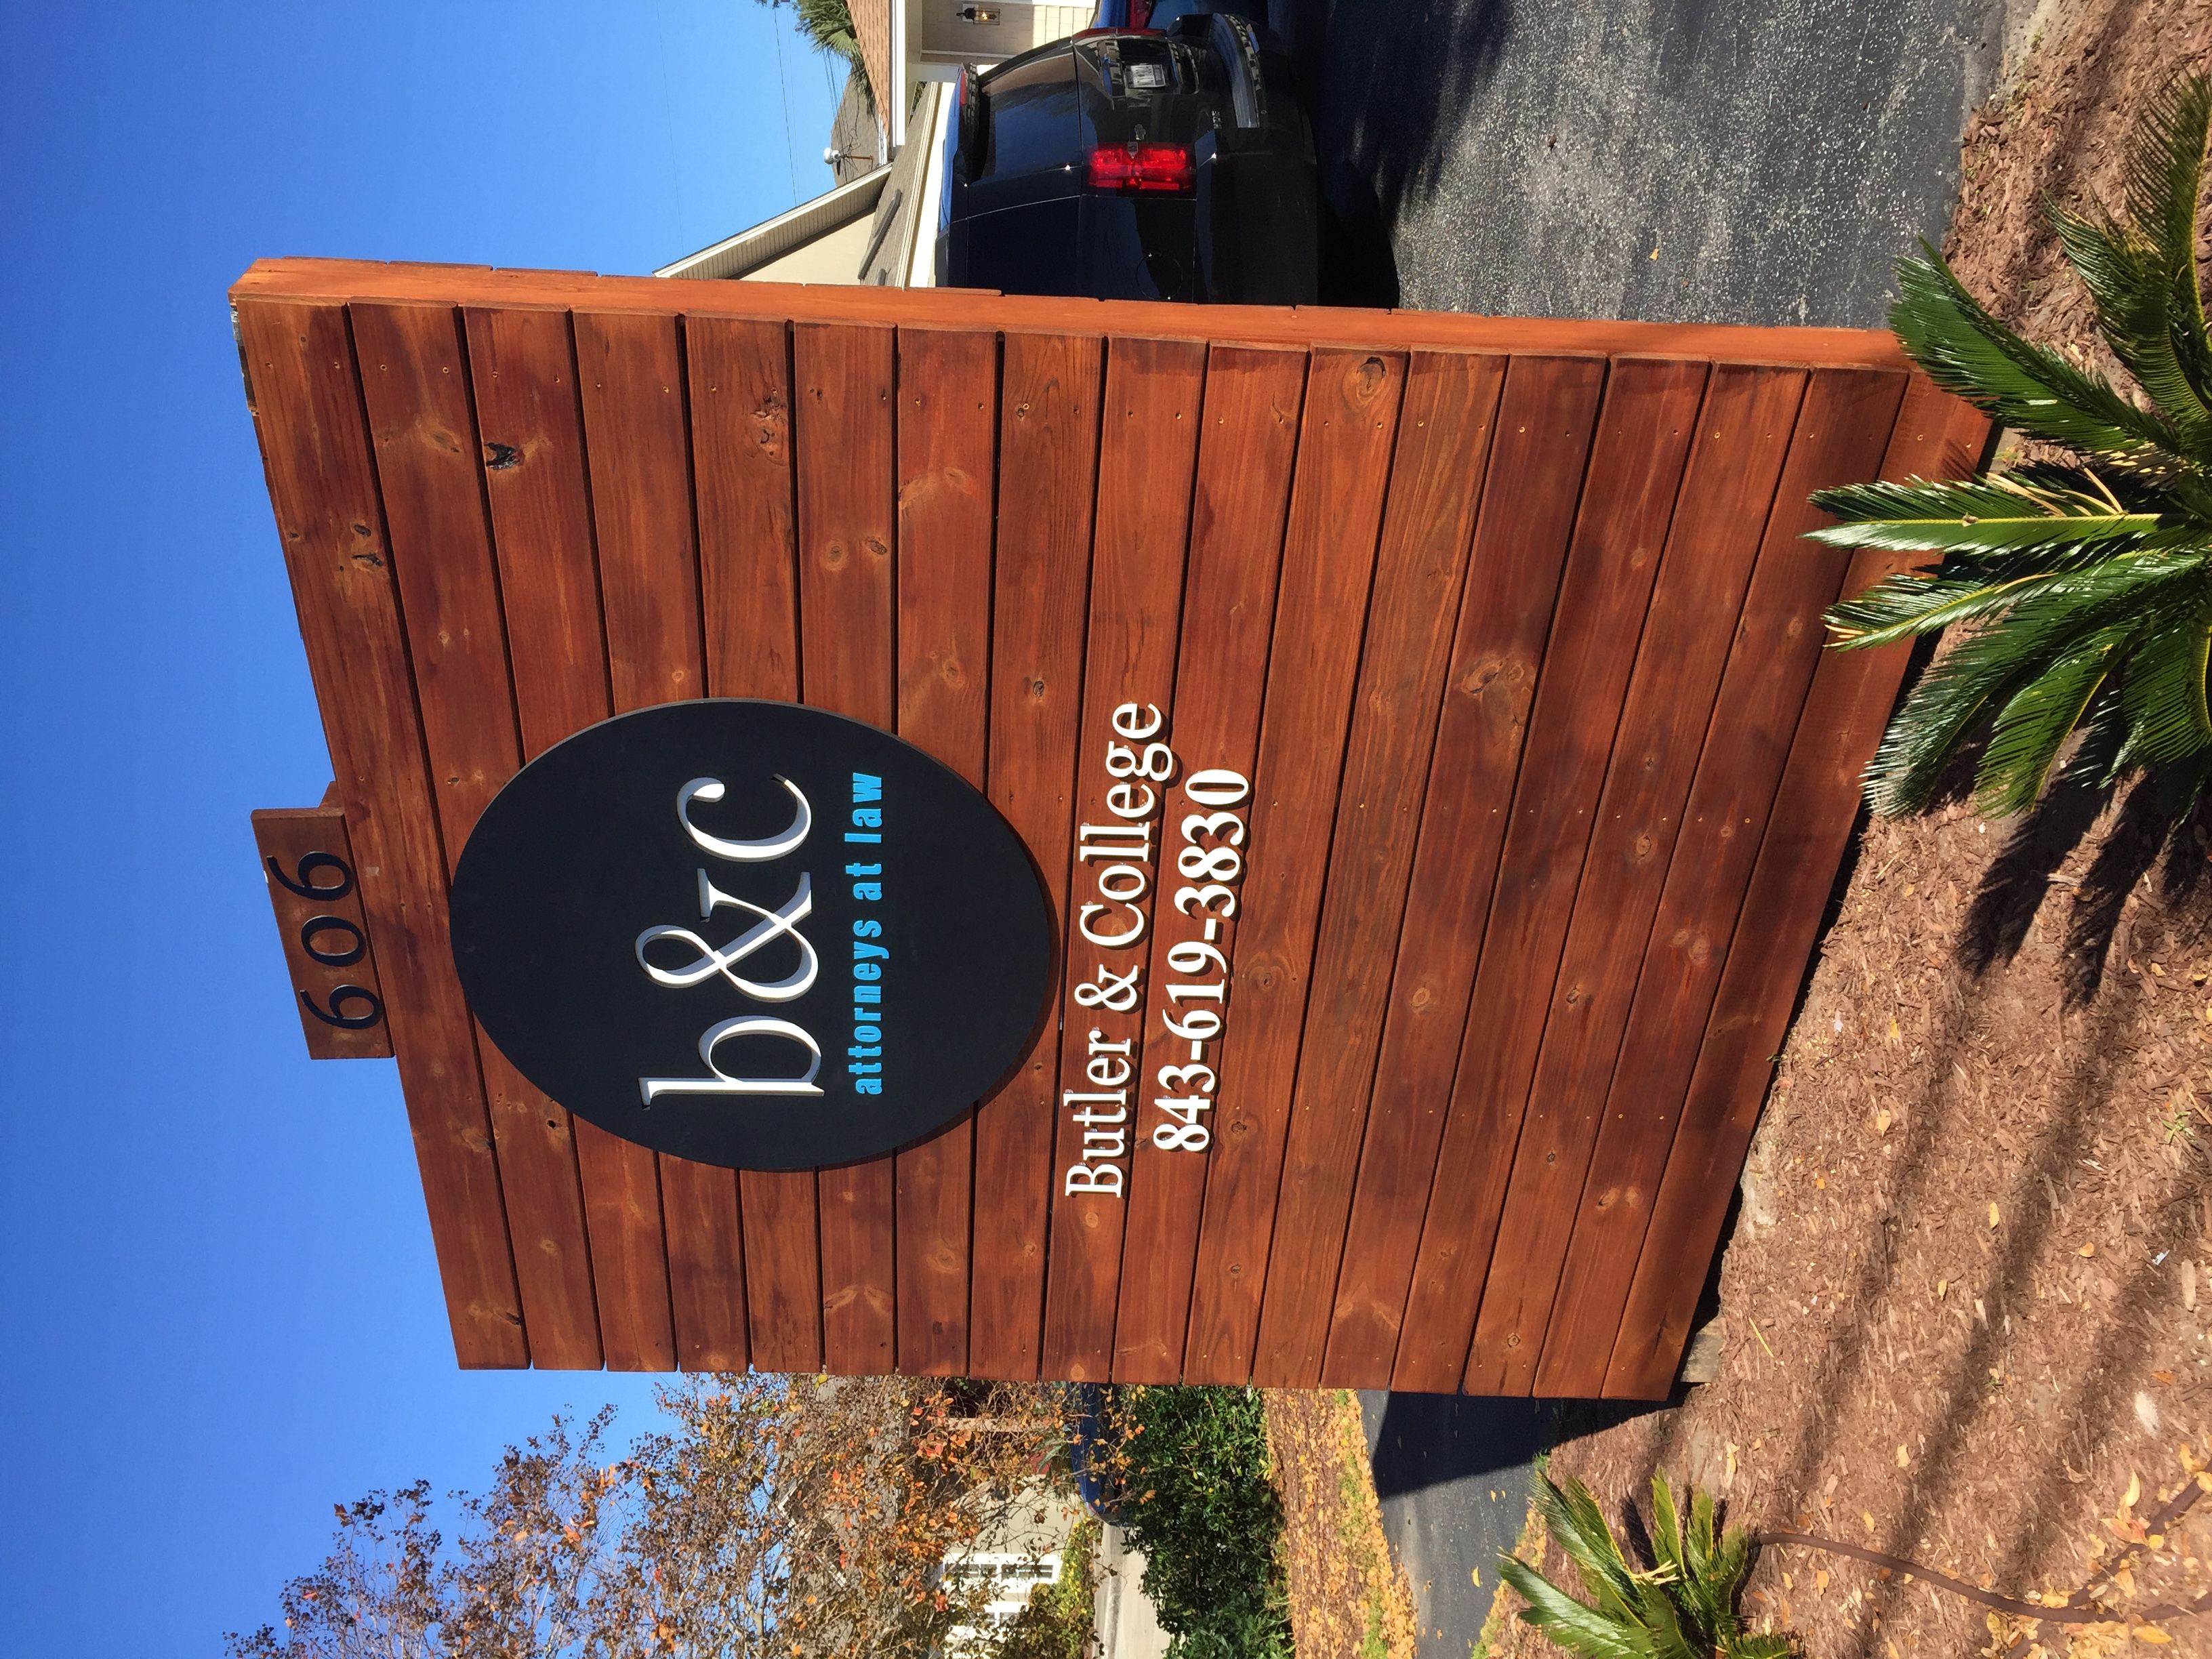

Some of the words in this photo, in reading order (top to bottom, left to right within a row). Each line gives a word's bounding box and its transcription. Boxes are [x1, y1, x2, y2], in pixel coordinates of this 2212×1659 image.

[844, 772, 882, 843] law
[845, 863, 882, 901] at
[1080, 702, 1172, 948] College
[267, 851, 383, 1029] 606
[635, 773, 824, 1109] b&c
[848, 920, 889, 1095] attorneys
[1075, 964, 1138, 1011] &
[1153, 769, 1249, 1152] 843-619-3830
[1063, 1029, 1132, 1198] Butler
